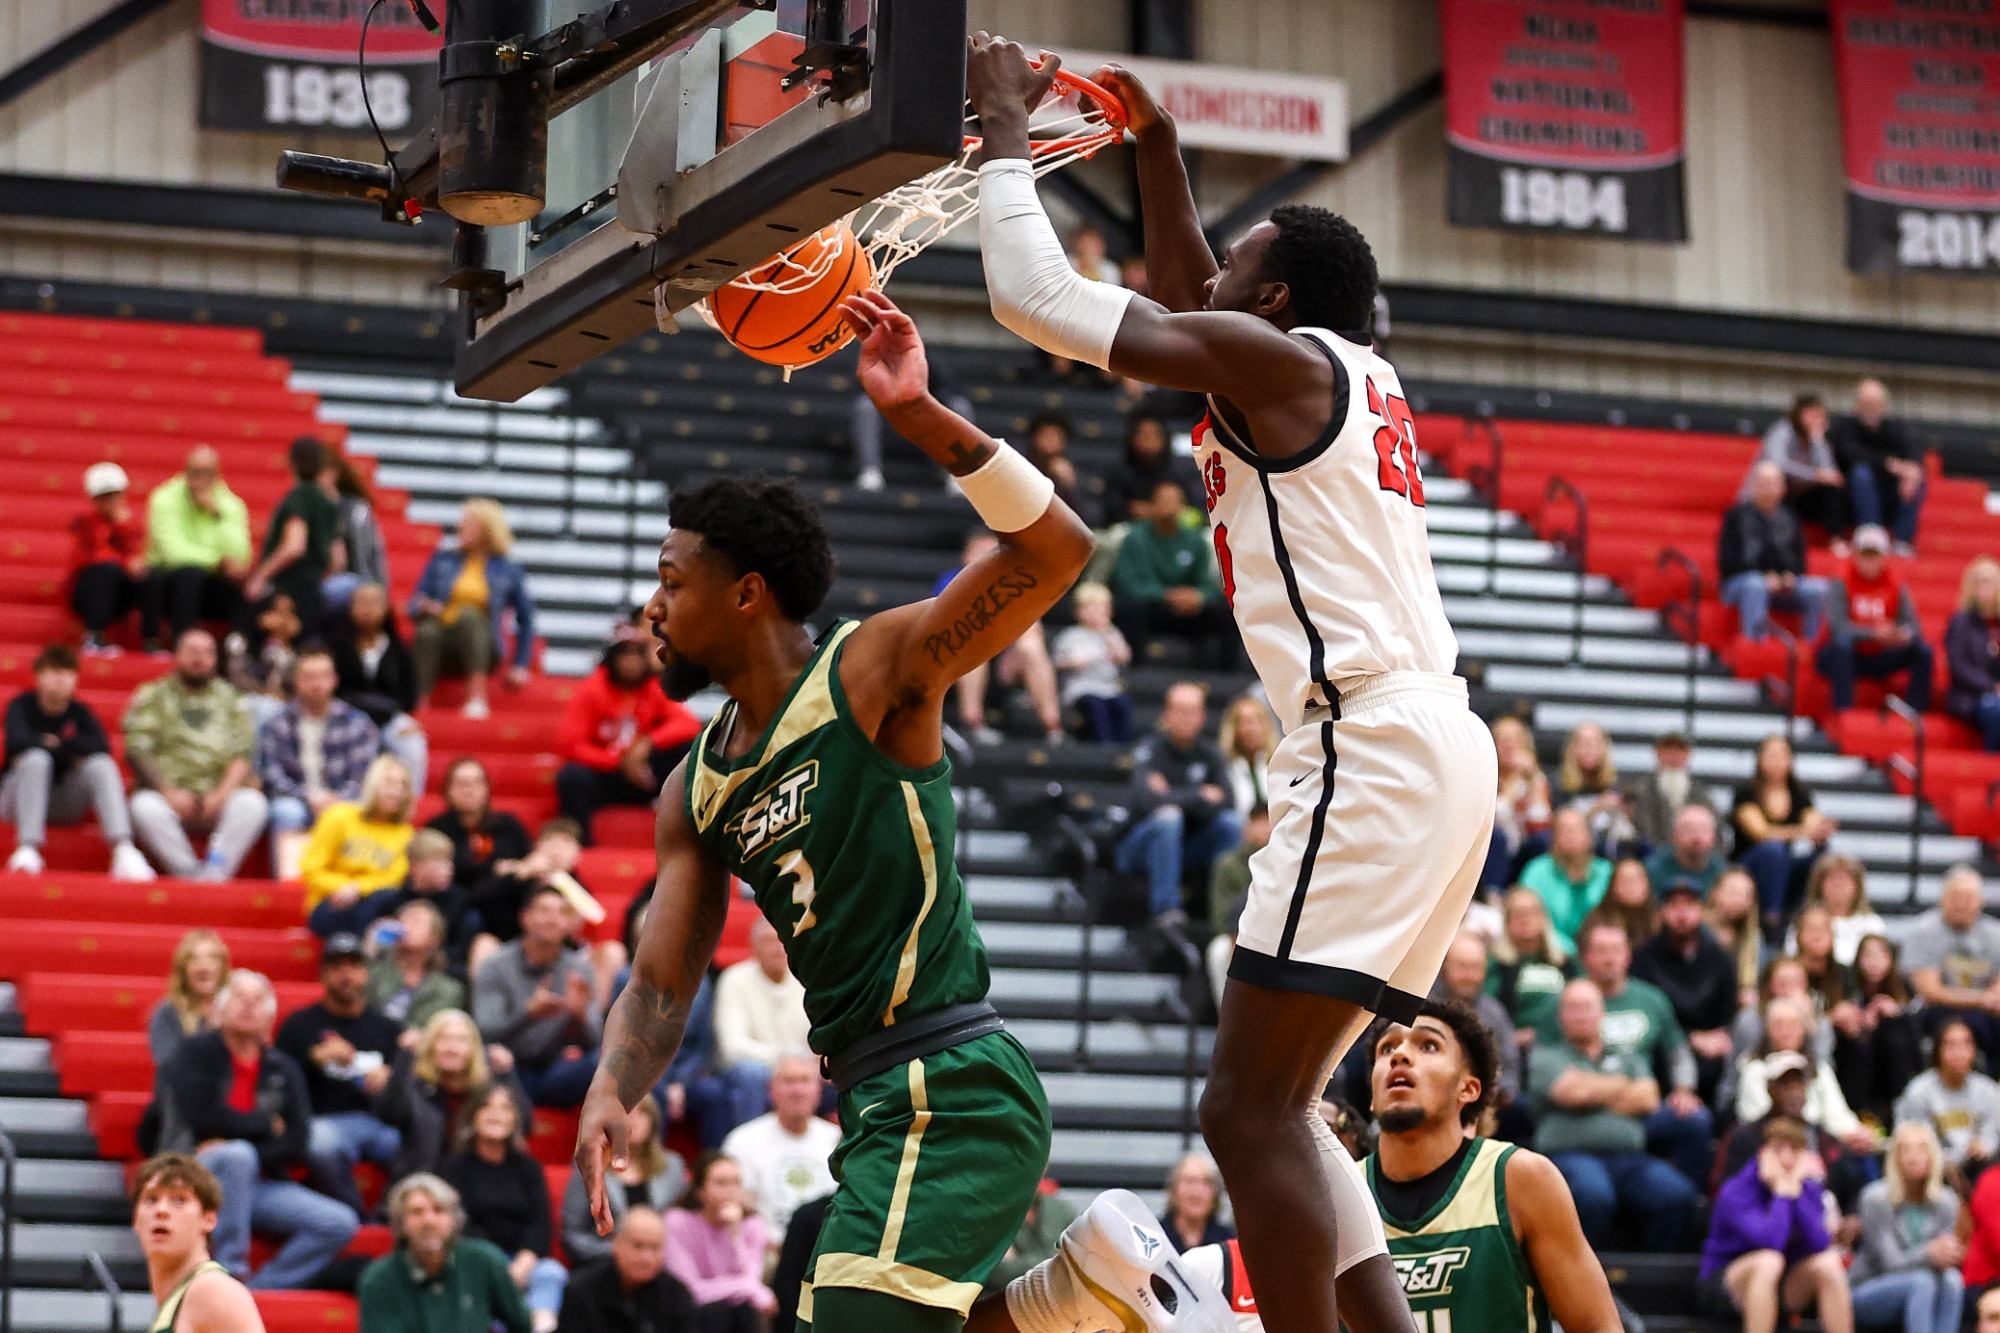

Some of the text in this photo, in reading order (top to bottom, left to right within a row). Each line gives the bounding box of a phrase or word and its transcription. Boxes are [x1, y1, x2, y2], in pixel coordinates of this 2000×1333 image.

[263, 65, 412, 130] 1938
[1502, 167, 1629, 233] 1984
[922, 564, 1038, 669] PROGRESS
[741, 769, 811, 854] S&T
